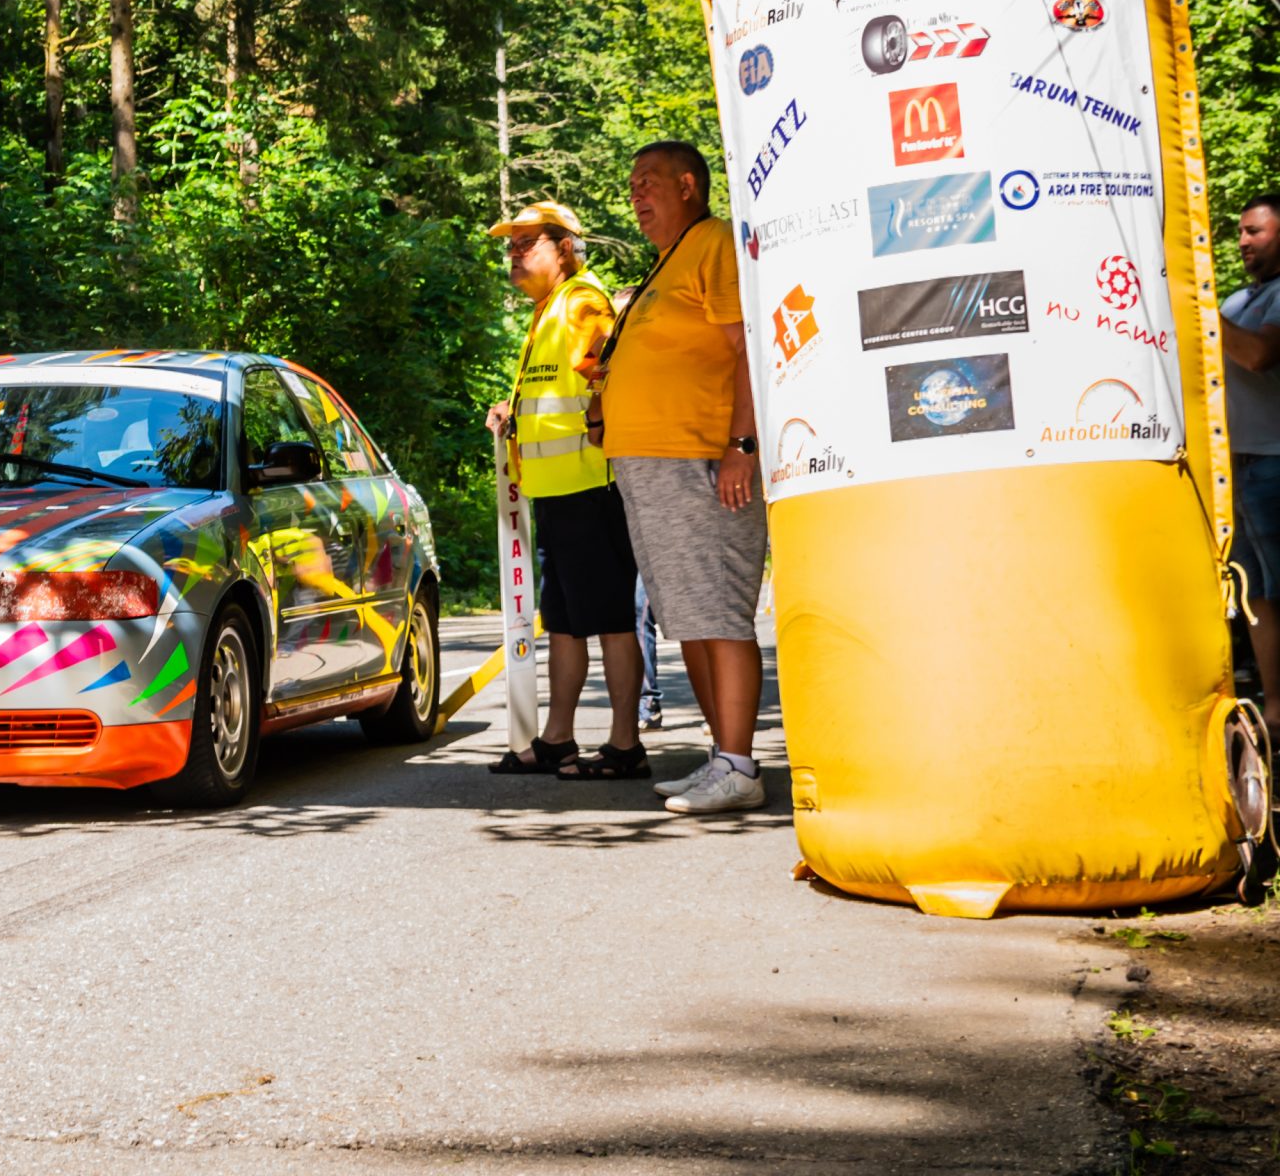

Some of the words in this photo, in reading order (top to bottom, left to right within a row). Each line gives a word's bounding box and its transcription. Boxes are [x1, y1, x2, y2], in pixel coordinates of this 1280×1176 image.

[724, 1, 804, 48] utoClubRally
[1010, 72, 1078, 107] BARUM
[1082, 94, 1142, 137] TEHNIK
[1048, 183, 1076, 196] ARCA
[1080, 183, 1102, 196] FIRE
[1105, 183, 1154, 197] SOLUTIONS
[757, 212, 803, 242] VICTORY
[979, 295, 1025, 318] HCG
[863, 332, 901, 345] HYDRAULIC
[901, 328, 928, 339] CENTER
[929, 325, 955, 336] GROUP
[1096, 313, 1169, 354] name
[1040, 422, 1172, 443] AutoClubRally
[770, 453, 845, 484] utoClubRally
[508, 482, 524, 614] START
